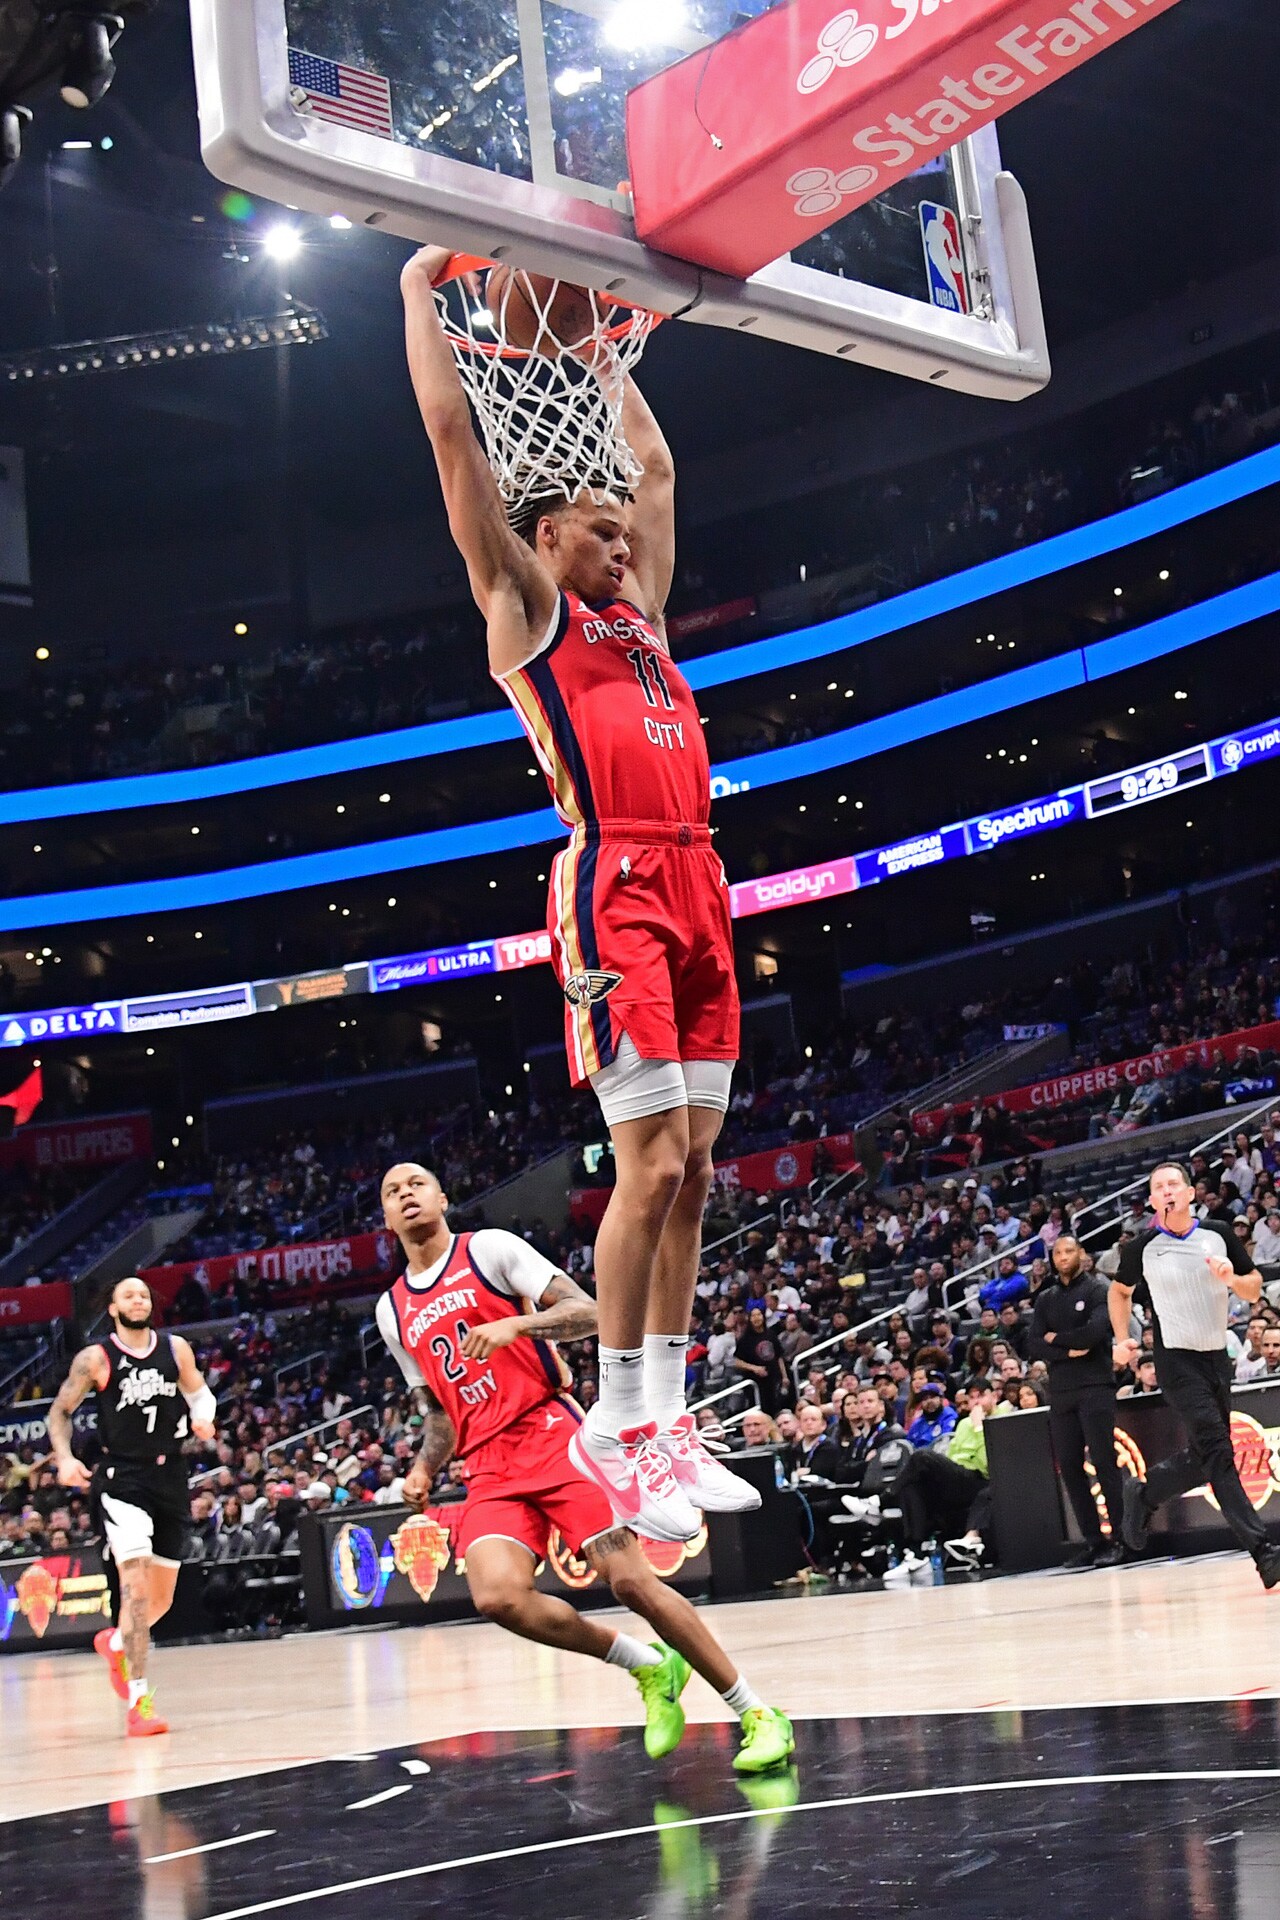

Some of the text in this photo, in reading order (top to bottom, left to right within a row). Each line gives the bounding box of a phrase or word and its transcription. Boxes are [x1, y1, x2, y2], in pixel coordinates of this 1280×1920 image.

[934, 286, 956, 310] NBA
[626, 647, 676, 711] 11
[643, 716, 686, 750] CITY
[1121, 762, 1179, 802] 9:29
[977, 798, 1070, 843] Spectrum
[877, 834, 942, 866] AMERICAN
[887, 846, 945, 875] EXPRESS
[755, 870, 835, 902] boldyn
[437, 950, 491, 972] ULTRA
[29, 1009, 116, 1037] DELTA
[1030, 1068, 1118, 1106] CLIPPERS
[407, 1288, 478, 1348] CRESCENT
[458, 1369, 497, 1405] CITY
[142, 1405, 158, 1434] 7
